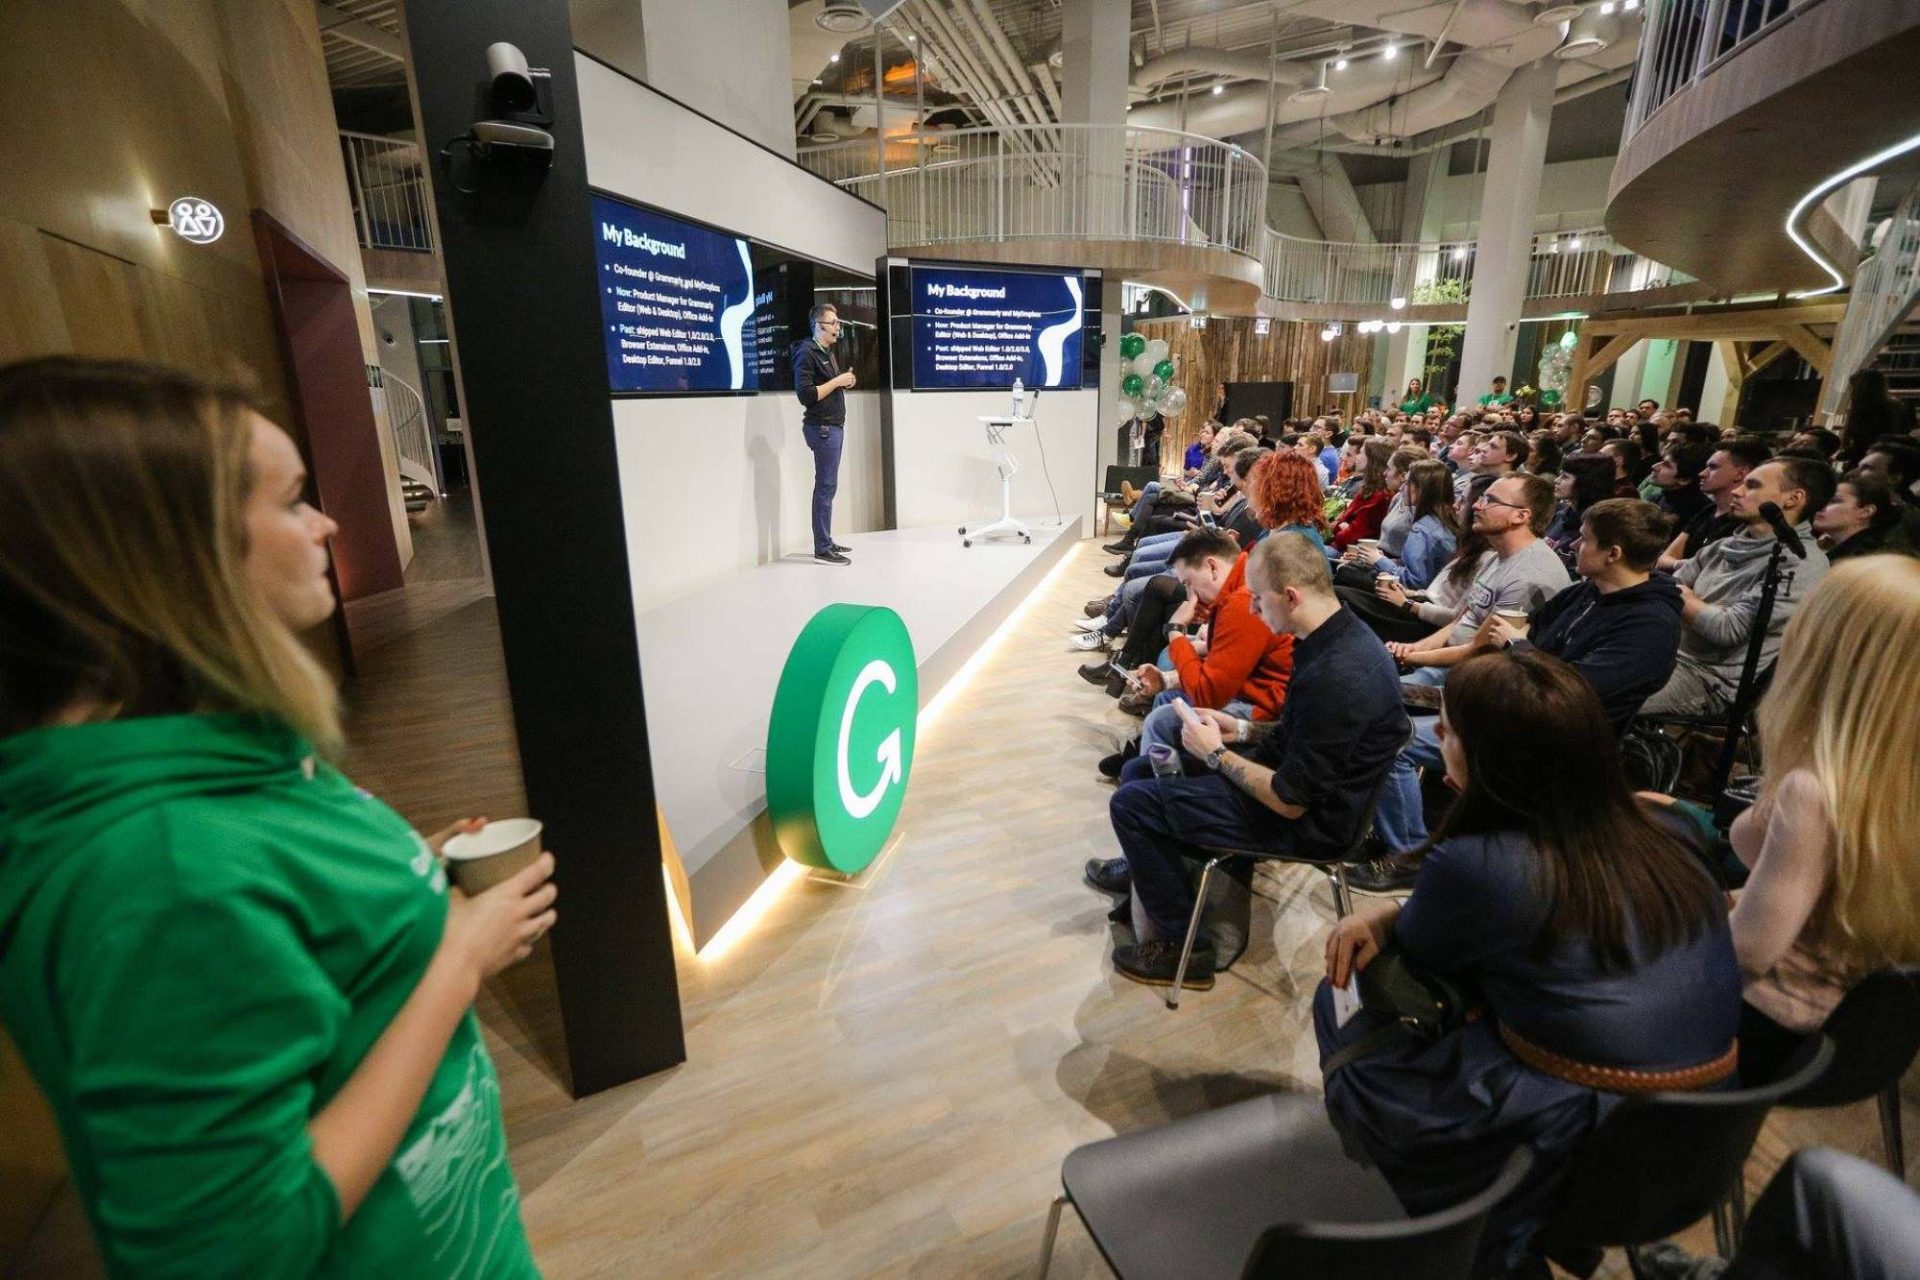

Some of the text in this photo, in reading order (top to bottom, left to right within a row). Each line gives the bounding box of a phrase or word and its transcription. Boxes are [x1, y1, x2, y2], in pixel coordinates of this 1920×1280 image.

[602, 222, 685, 259] My Background
[613, 263, 647, 279] Co-founder
[927, 283, 1006, 299] My Background
[616, 286, 633, 298] Now:
[633, 289, 655, 301] Product
[656, 293, 679, 306] Manager
[688, 298, 714, 312] Grammarly
[618, 301, 636, 312] Editor
[637, 304, 651, 315] (Web
[683, 311, 698, 321] Office
[934, 307, 965, 315] Co-founder
[620, 324, 636, 334] Past:
[637, 326, 658, 338] shipped
[672, 329, 687, 339] Editor
[972, 322, 995, 331] Manager
[935, 331, 951, 339] Editor
[998, 332, 1013, 340] Office
[621, 339, 645, 350] Browser
[677, 343, 692, 353] Office
[985, 345, 1000, 353] Editor
[622, 354, 647, 368] Desktop
[935, 363, 958, 372] Desktop
[837, 659, 901, 819] G
